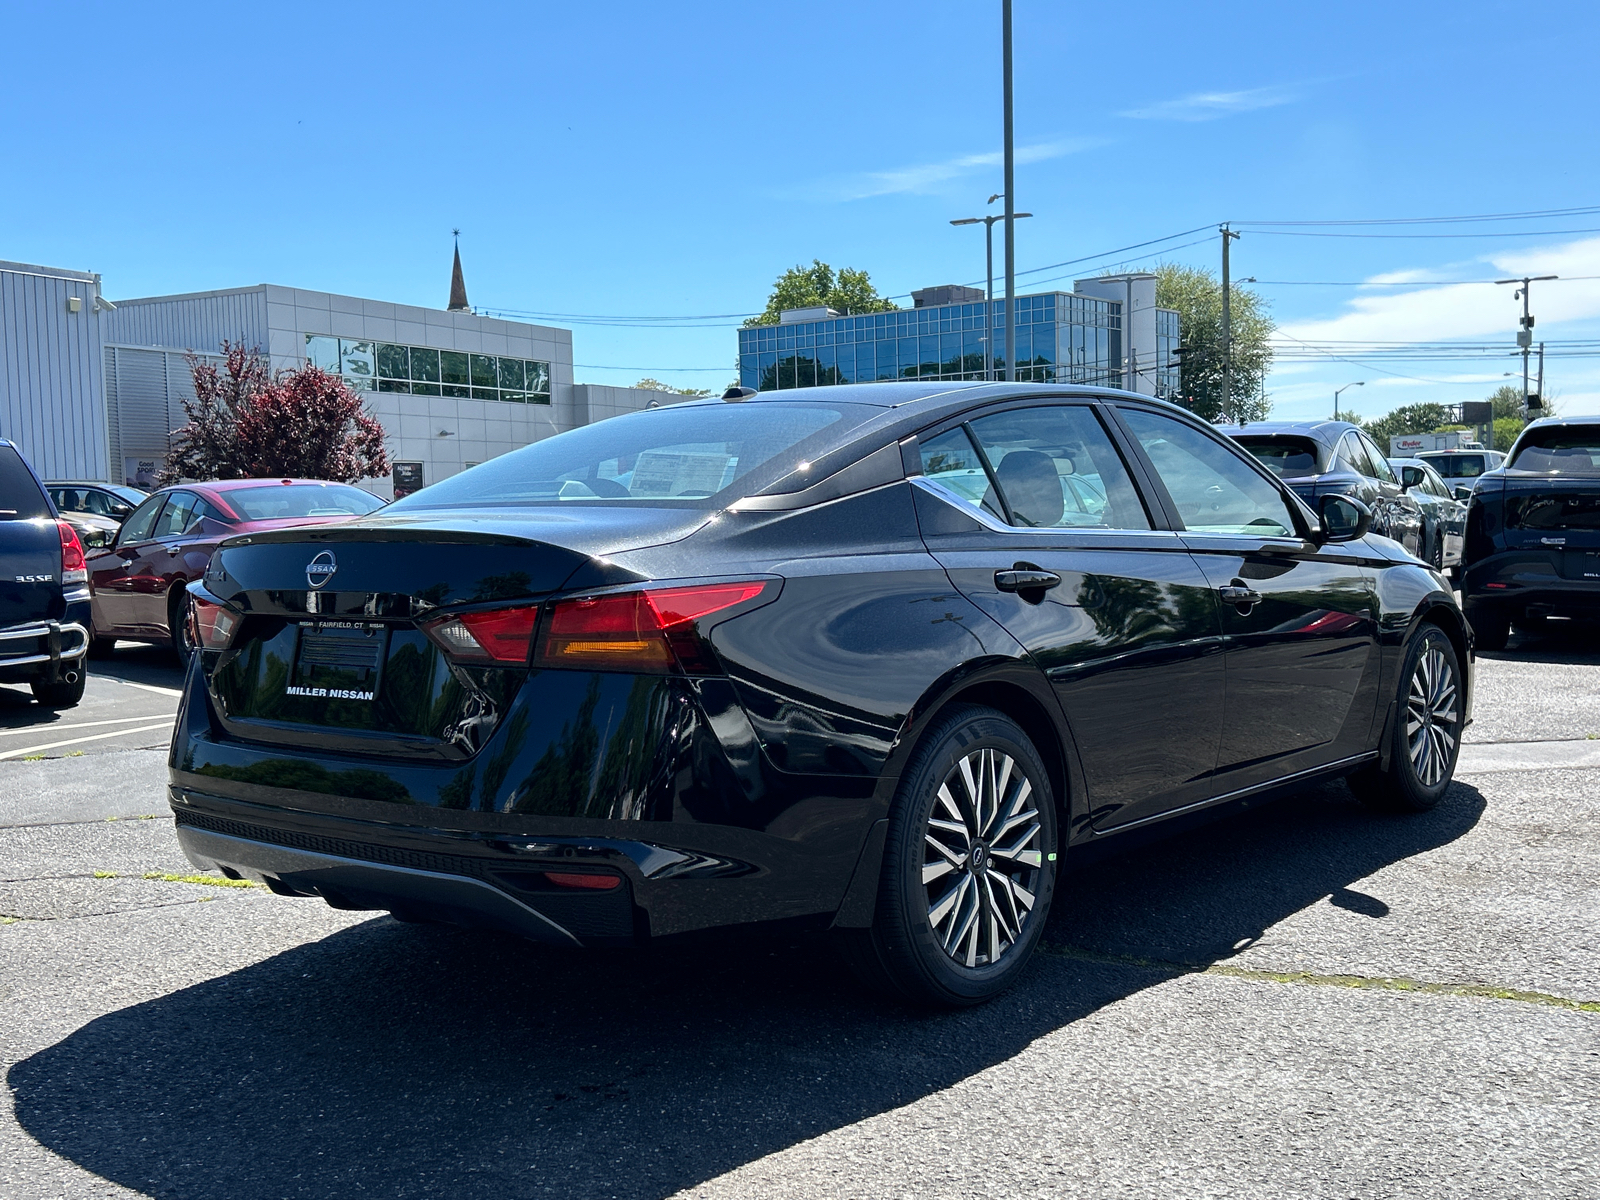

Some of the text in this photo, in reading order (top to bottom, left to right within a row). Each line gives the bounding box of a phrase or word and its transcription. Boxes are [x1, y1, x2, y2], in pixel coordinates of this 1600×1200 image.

[306, 565, 337, 573] SSAN
[36, 574, 53, 582] SE
[286, 686, 374, 700] MILLER NISSAN
